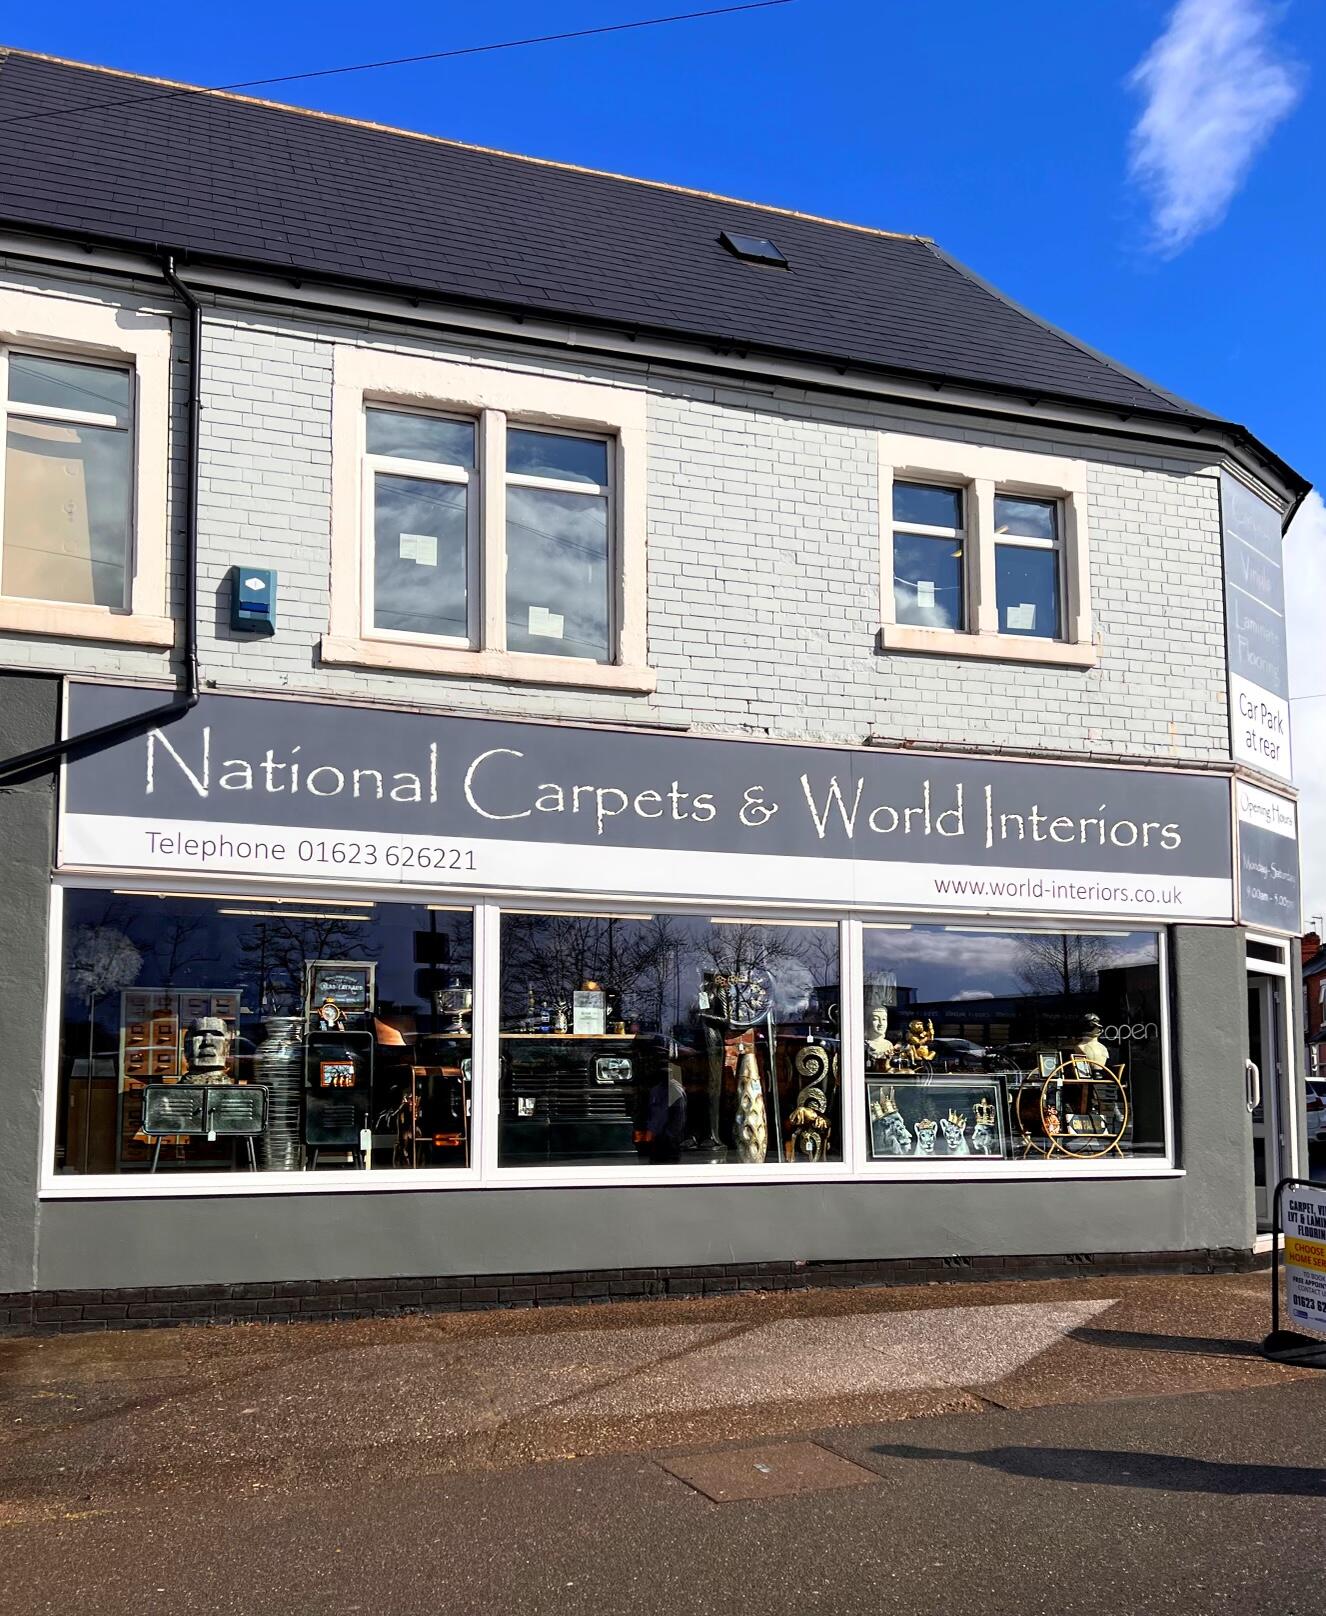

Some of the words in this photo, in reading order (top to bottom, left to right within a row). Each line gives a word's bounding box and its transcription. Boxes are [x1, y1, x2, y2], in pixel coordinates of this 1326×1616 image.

[1239, 692, 1258, 721] Car
[1261, 702, 1284, 735] Park
[1246, 729, 1257, 751] at
[1259, 737, 1280, 761] rear
[145, 726, 438, 803] National
[463, 748, 717, 835] Carpets
[738, 785, 779, 827] &
[799, 773, 965, 839] World
[984, 784, 1183, 850] Interiors
[1240, 791, 1271, 824] Opening
[1271, 803, 1293, 827] Hours
[145, 830, 286, 862] Telephone
[298, 840, 378, 866] 01623
[385, 846, 478, 871] 626221
[934, 878, 1183, 905] www.world-interiors.co.uk
[1104, 1022, 1159, 1046] open
[1287, 1210, 1298, 1224] LVT
[1289, 1199, 1317, 1217] CARPET,
[1289, 1251, 1312, 1265] HOME
[1294, 1242, 1325, 1257] CHOOSE
[1293, 1293, 1315, 1310] 01623
